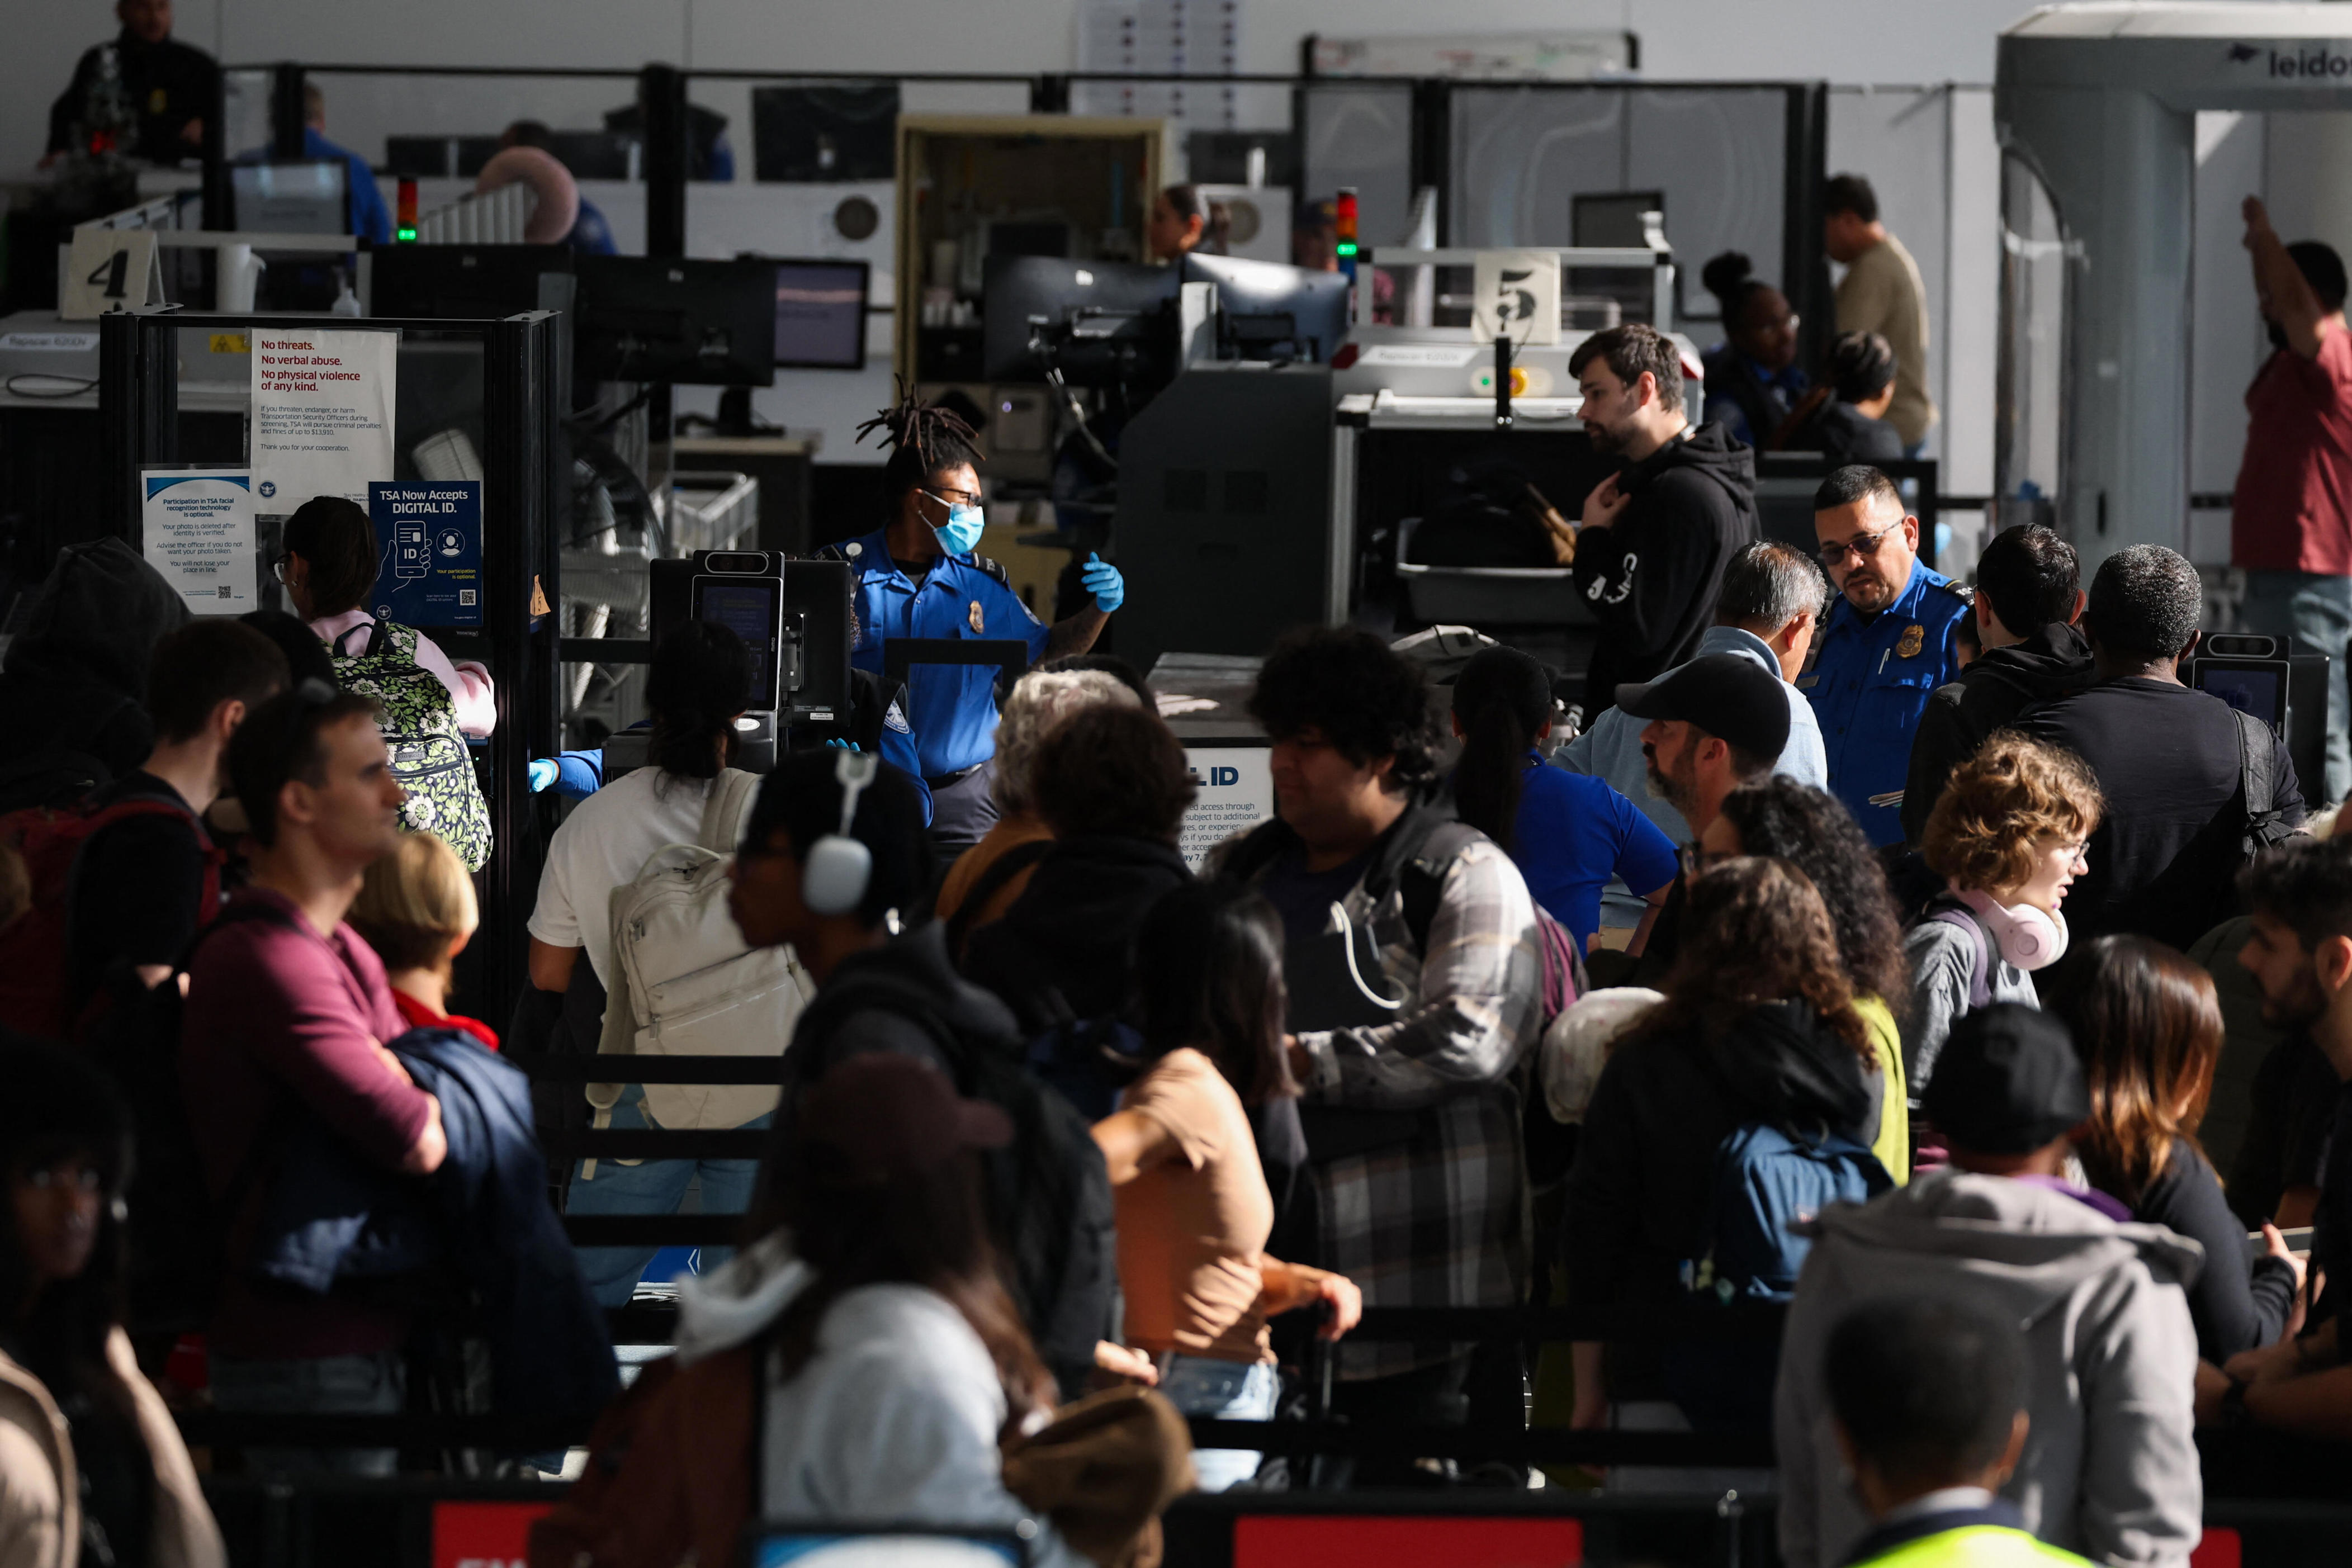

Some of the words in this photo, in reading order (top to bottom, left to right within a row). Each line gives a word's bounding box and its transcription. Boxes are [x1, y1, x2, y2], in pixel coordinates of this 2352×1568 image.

[2270, 48, 2352, 77] leido
[87, 249, 128, 296] 4
[1497, 269, 1536, 320] 5
[261, 340, 275, 349] No
[278, 341, 315, 350] threats.
[261, 356, 275, 364] No
[278, 356, 309, 365] verbal
[311, 356, 342, 366] abuse.
[261, 370, 275, 378] No
[278, 370, 317, 381] physical
[319, 371, 360, 381] violence
[261, 381, 272, 390] of
[274, 383, 292, 392] any
[295, 381, 319, 391] kind.
[380, 490, 400, 500] TSA
[402, 490, 427, 500] Now
[428, 489, 468, 501] Accepts
[392, 502, 439, 514] DIGITAL
[442, 502, 457, 514] ID.
[404, 548, 417, 559] ID
[1210, 766, 1239, 786] ID
[1225, 802, 1255, 811] through
[1185, 813, 1212, 822] subject
[1223, 812, 1260, 821] additional
